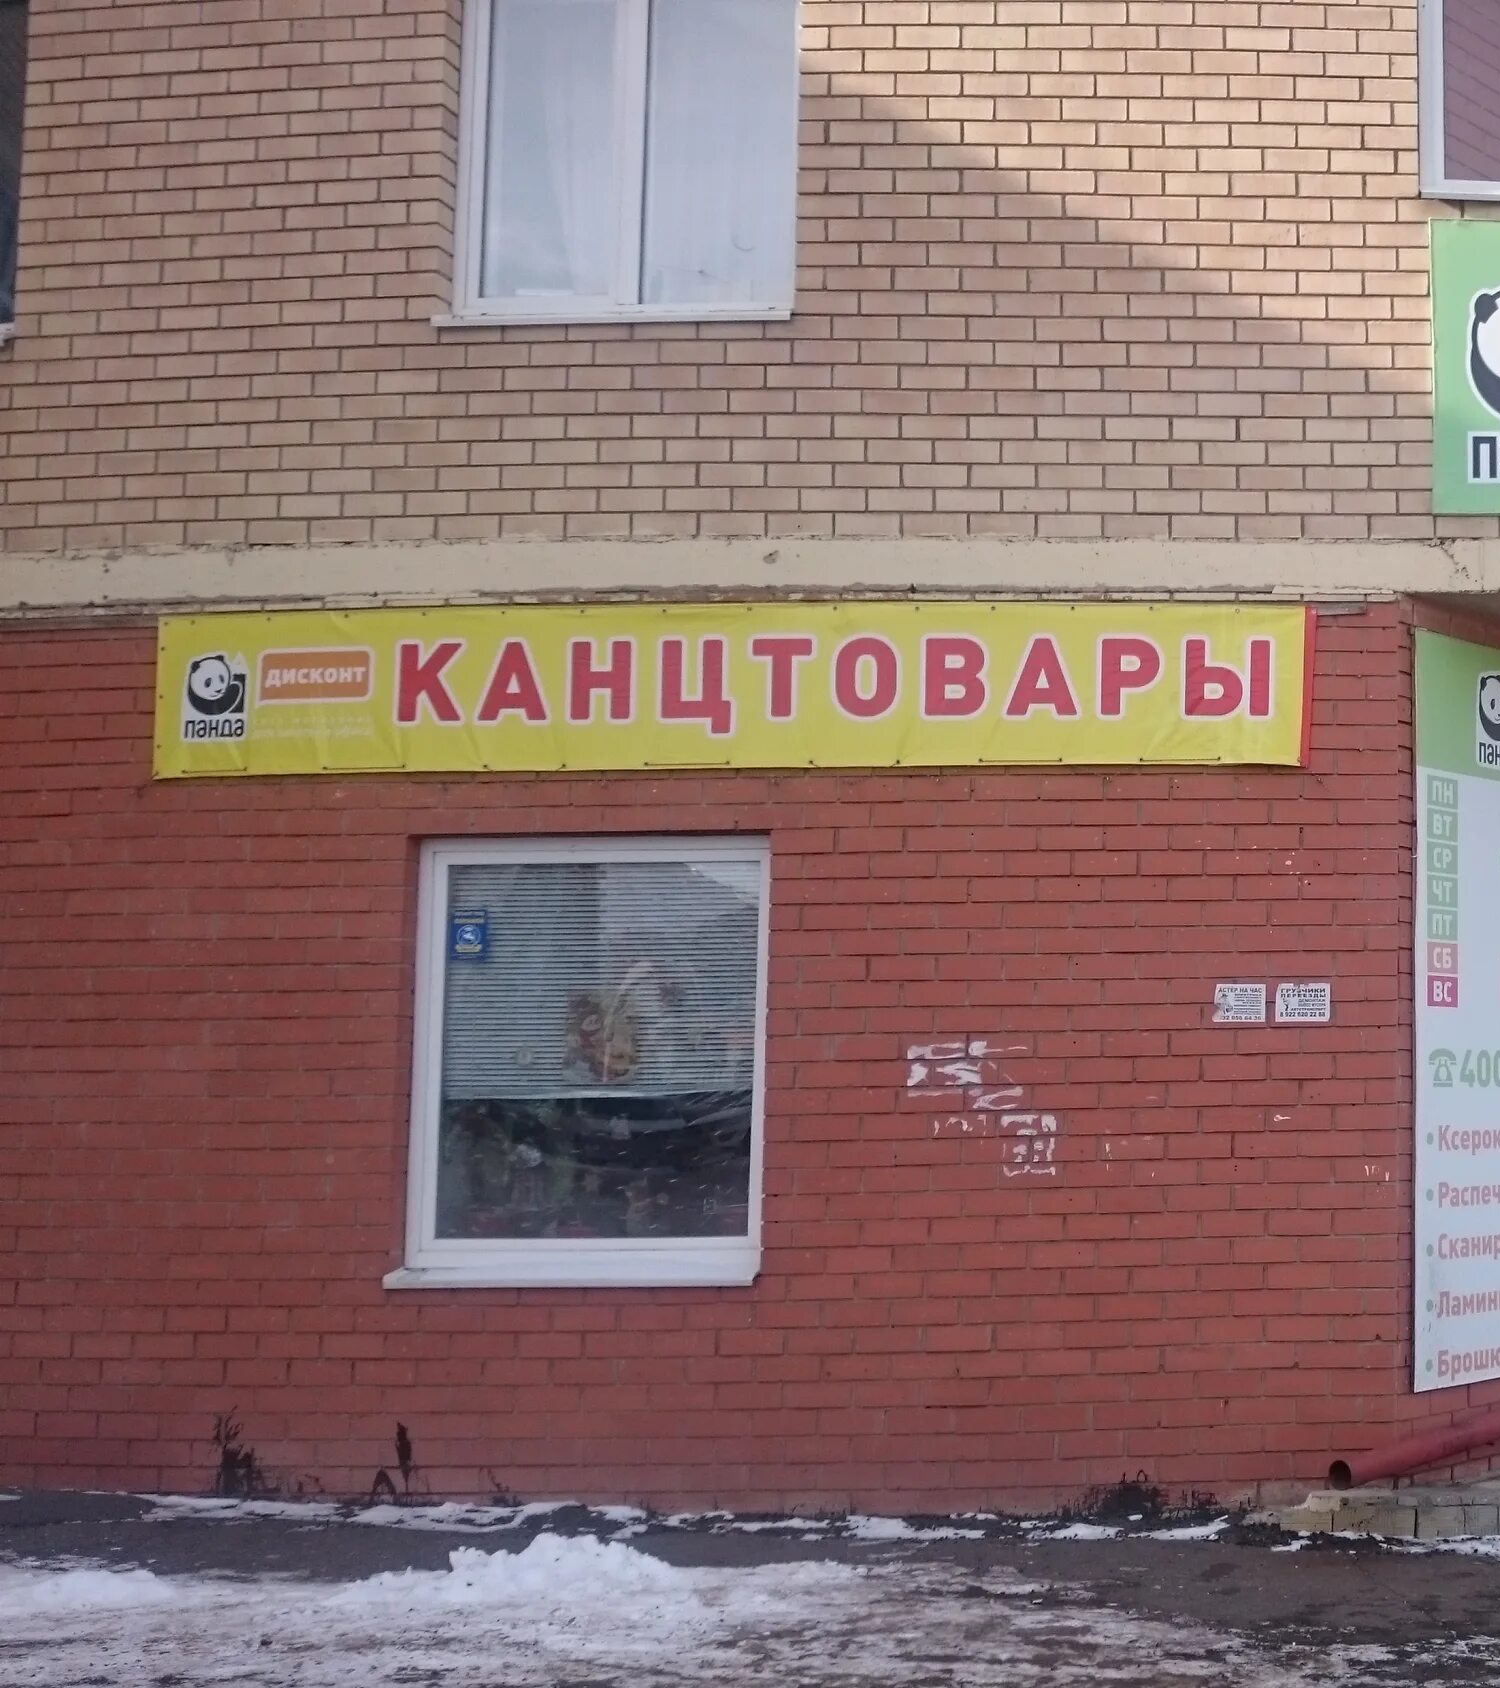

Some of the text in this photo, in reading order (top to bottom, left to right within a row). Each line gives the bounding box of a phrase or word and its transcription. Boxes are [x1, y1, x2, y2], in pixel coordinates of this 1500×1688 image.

[397, 636, 1273, 734] КАНЦТОВАРЫ
[1432, 780, 1453, 804] ПН
[1433, 812, 1453, 836] ВТ
[1433, 847, 1452, 868] СР
[1433, 880, 1453, 903] ЧТ
[1432, 913, 1453, 935] ПТ
[1433, 947, 1452, 970] СБ
[1433, 980, 1453, 1003] ВС
